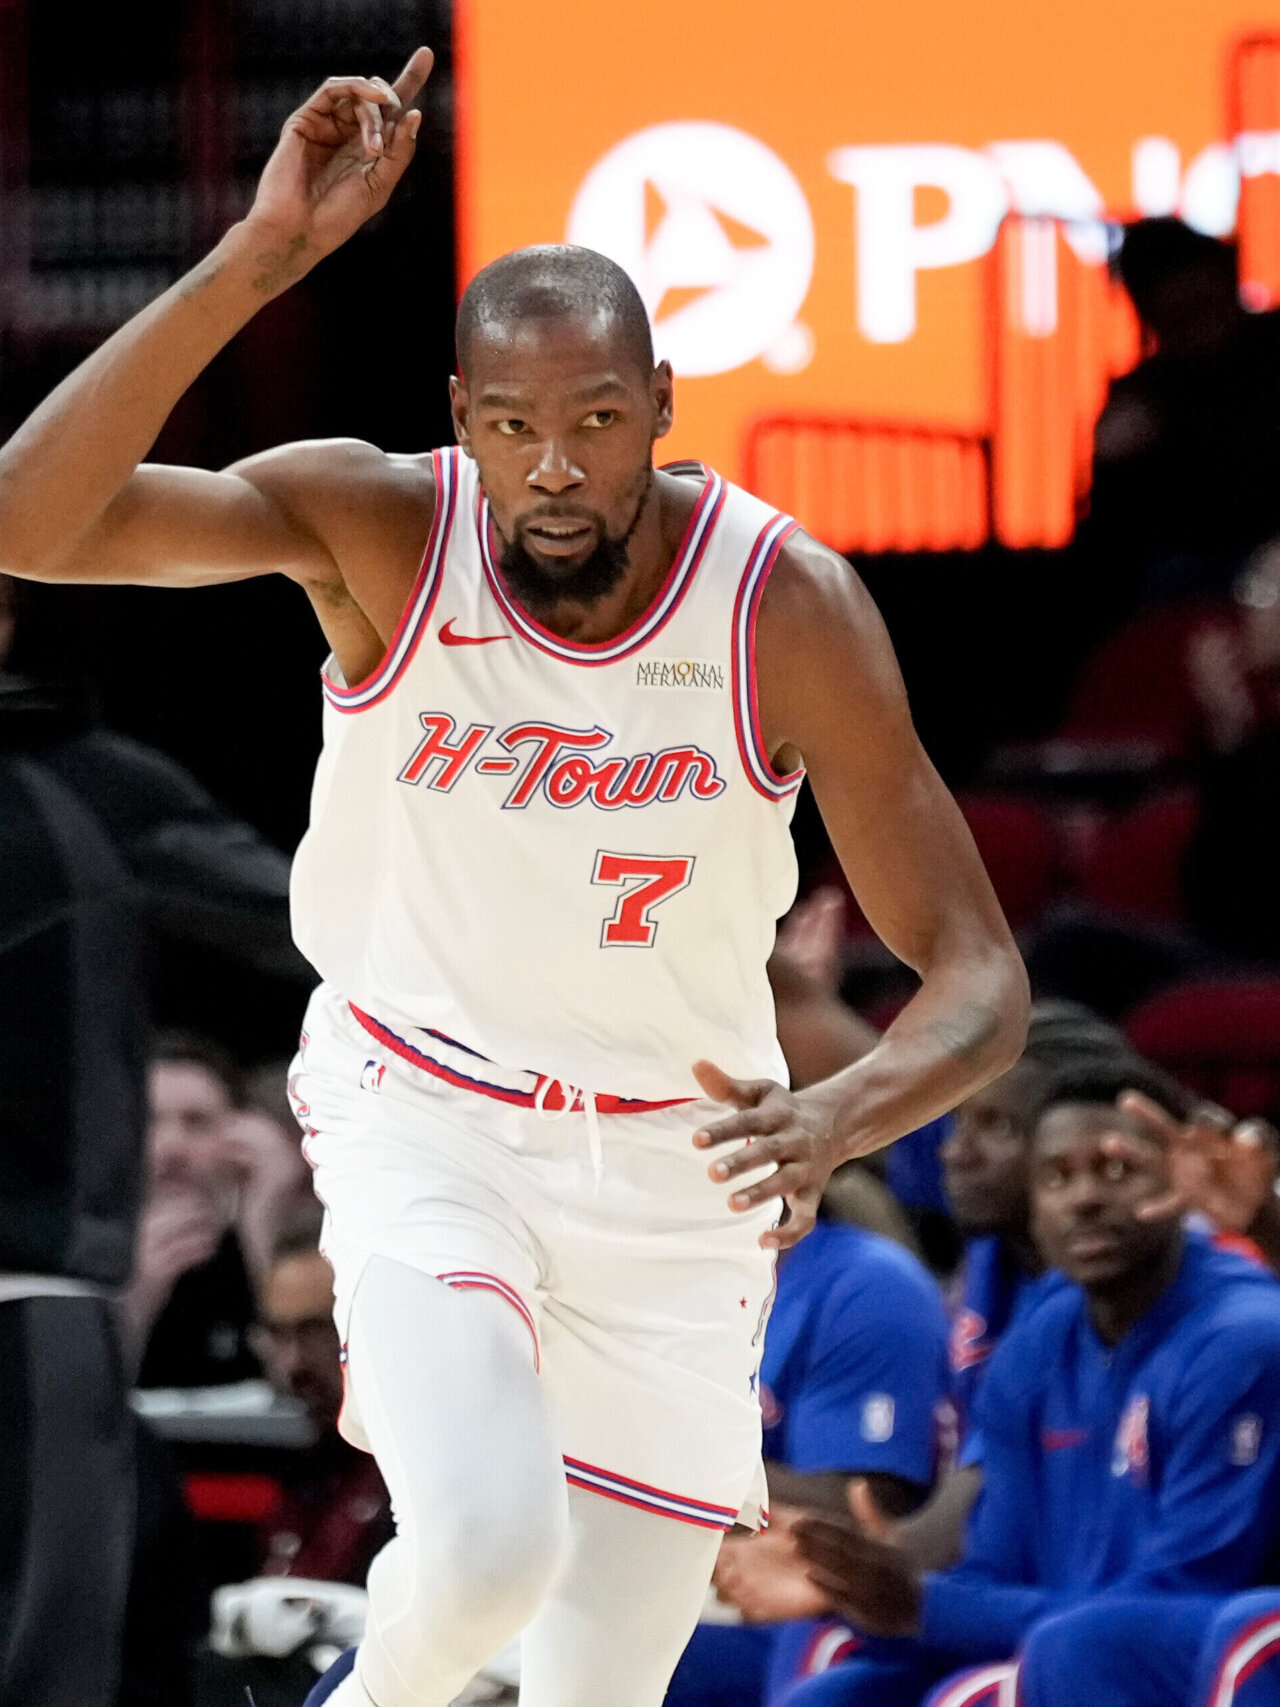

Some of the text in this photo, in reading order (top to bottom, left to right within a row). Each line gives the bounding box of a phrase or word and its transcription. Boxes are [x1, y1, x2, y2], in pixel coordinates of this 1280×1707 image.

[636, 673, 724, 689] HERMANN
[637, 660, 724, 679] MEMORIAL
[396, 711, 727, 811] H-Town
[590, 849, 696, 948] 7
